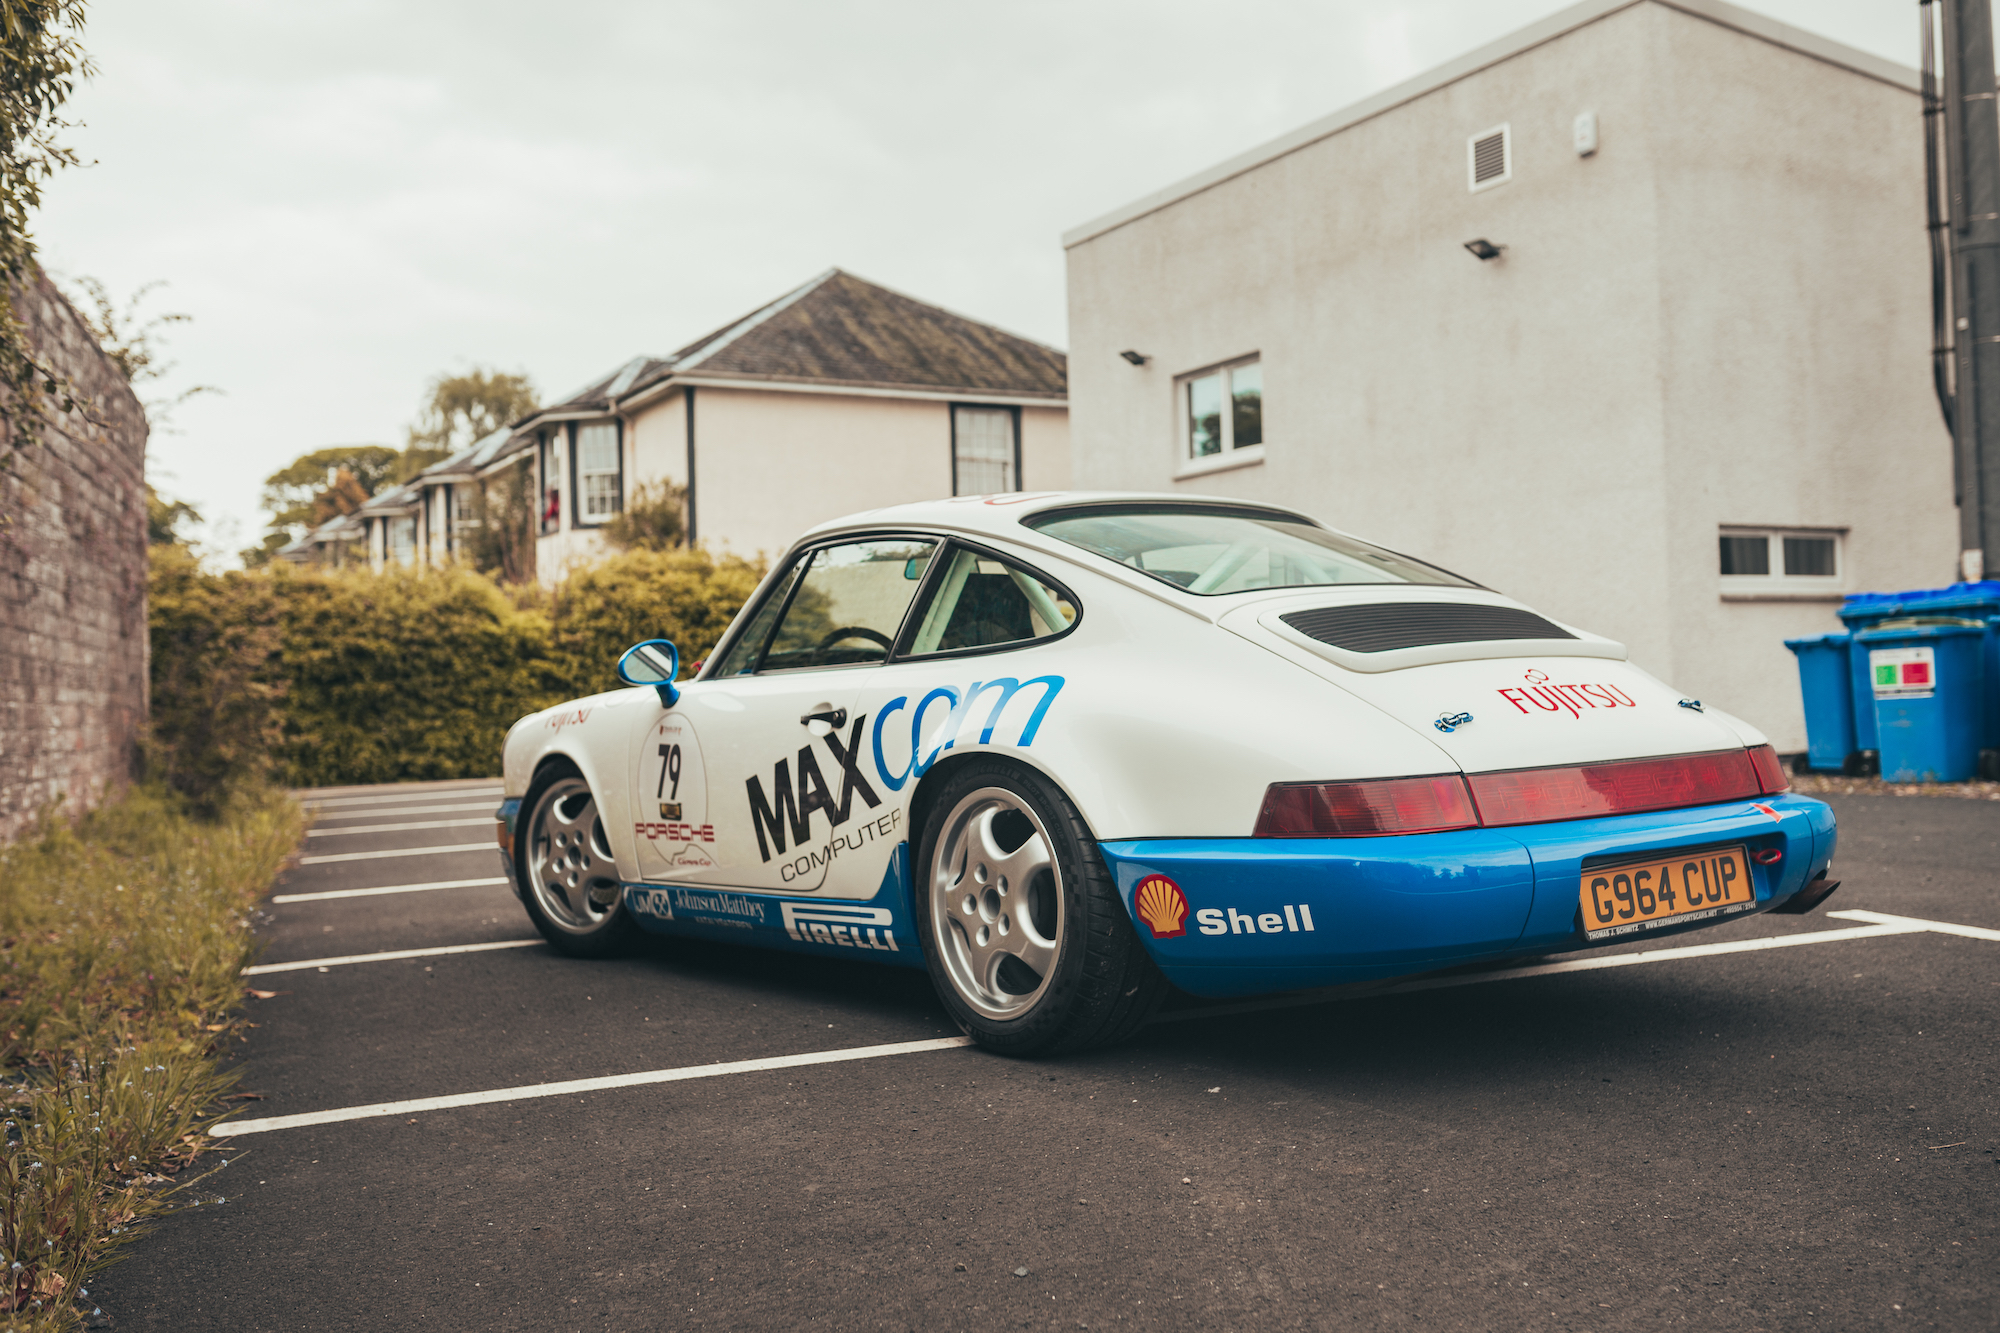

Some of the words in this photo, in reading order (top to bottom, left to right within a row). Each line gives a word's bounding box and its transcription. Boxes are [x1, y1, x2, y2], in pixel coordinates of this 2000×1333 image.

[1496, 684, 1637, 720] FUJITSU
[657, 743, 682, 800] 79
[1498, 764, 1744, 811] PORSCH
[635, 823, 715, 842] PORSCHE
[675, 889, 720, 911] Johnson
[719, 893, 765, 923] Matthey
[1591, 866, 1677, 924] G964
[1682, 856, 1737, 906] CUP
[780, 901, 900, 952] PIRELLI
[1196, 904, 1315, 936] Shell
